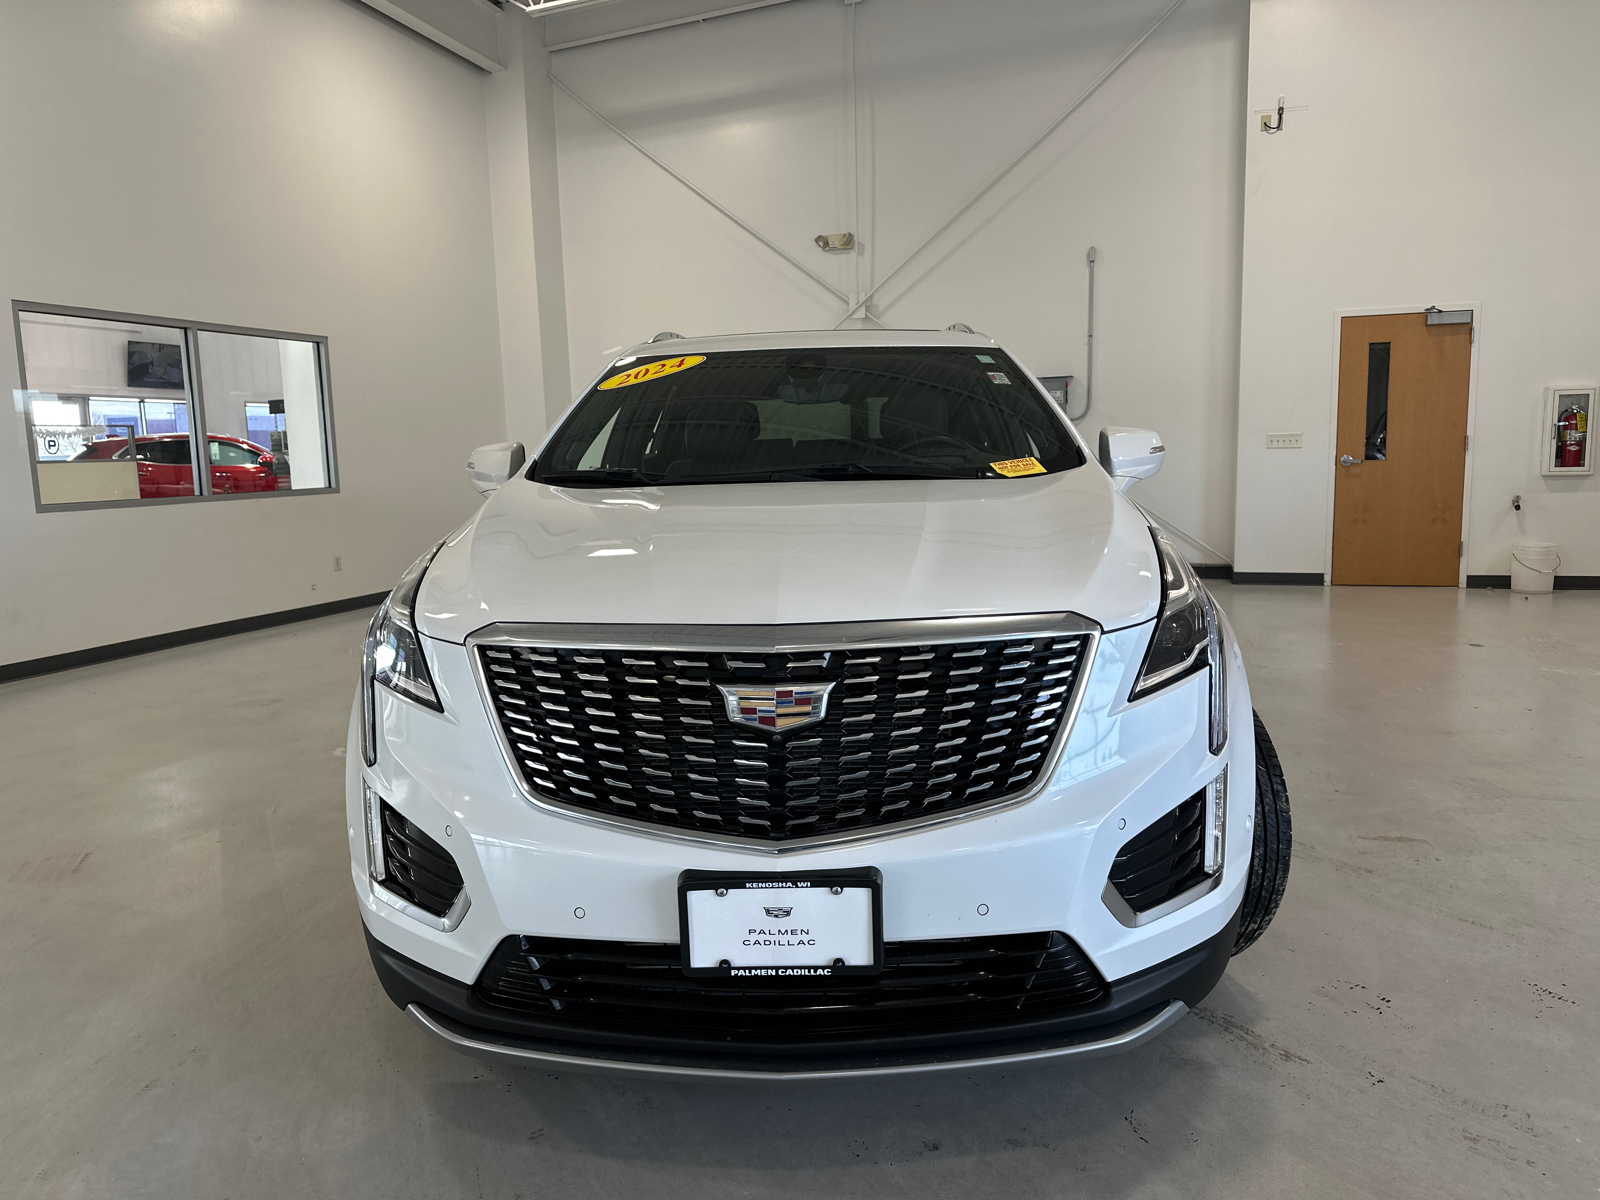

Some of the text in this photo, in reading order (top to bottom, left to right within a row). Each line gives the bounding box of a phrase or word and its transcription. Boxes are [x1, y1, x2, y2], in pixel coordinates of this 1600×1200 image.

[616, 358, 687, 386] 2024
[748, 928, 810, 936] PALMEN
[778, 968, 832, 976] CADILLAC
